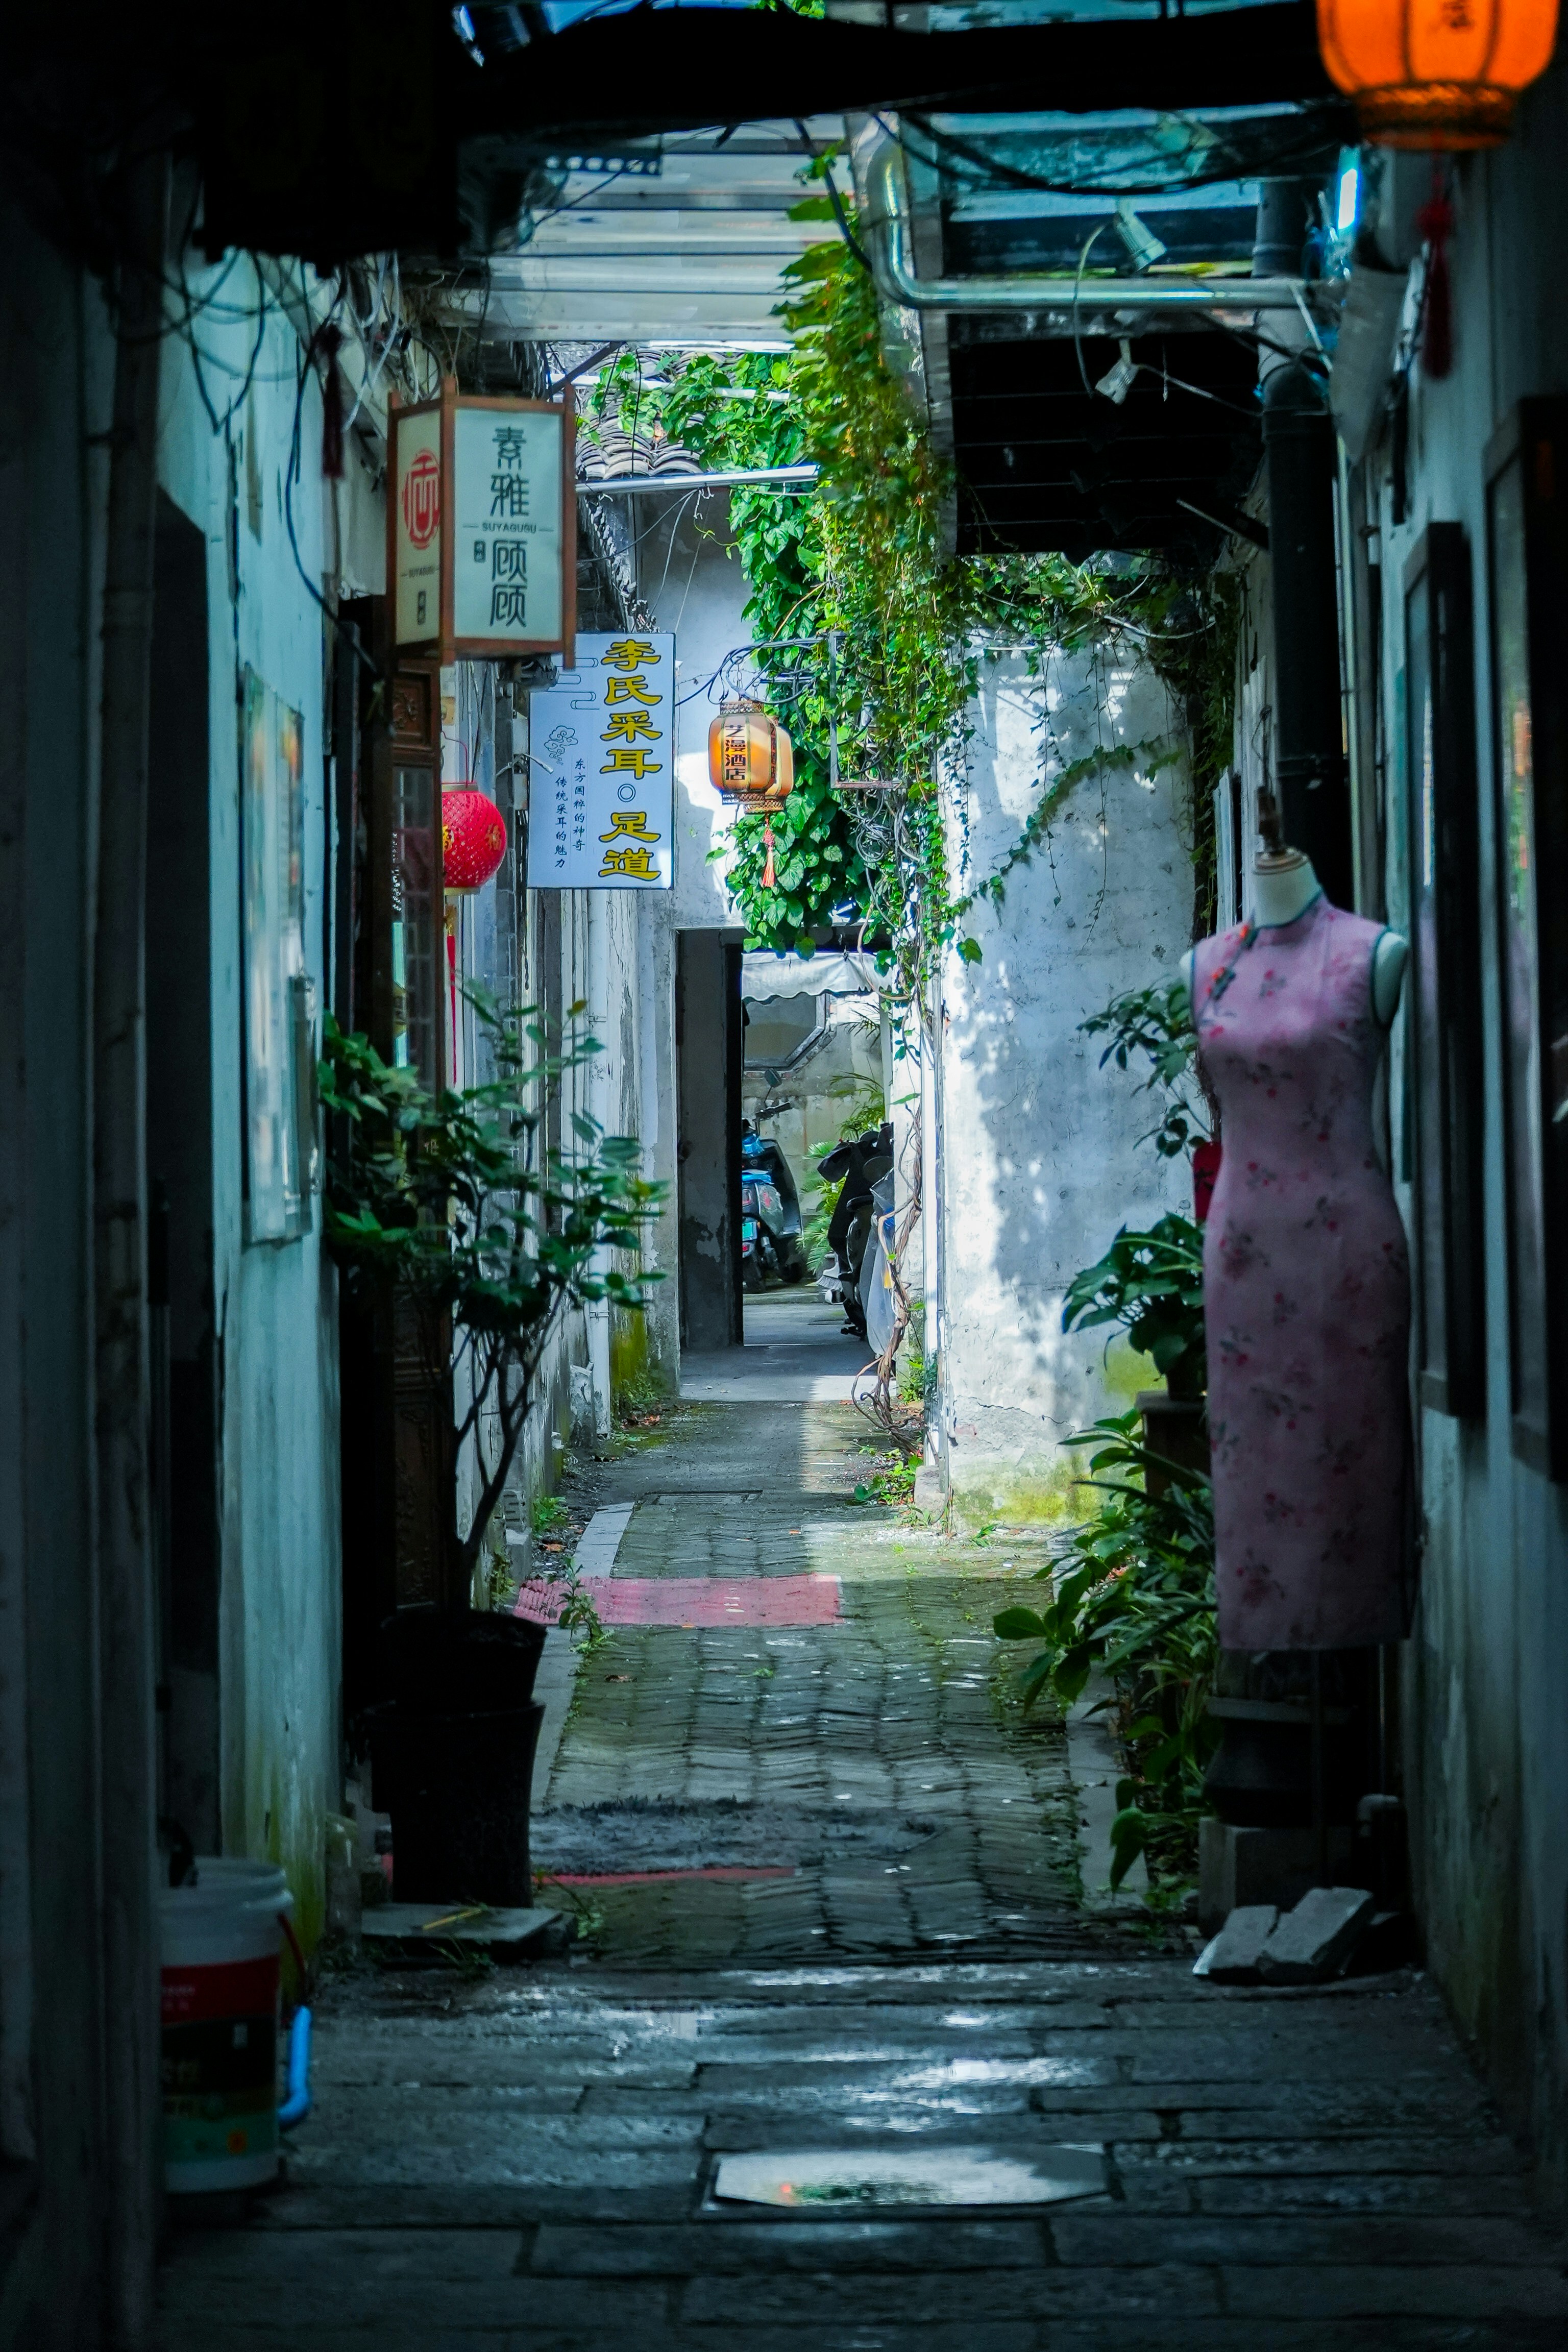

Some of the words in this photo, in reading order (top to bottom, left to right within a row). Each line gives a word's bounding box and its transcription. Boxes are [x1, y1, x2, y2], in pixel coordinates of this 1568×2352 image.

[482, 522, 536, 534] SUYAGUGU
[599, 639, 664, 780] 李氏采耳
[554, 776, 568, 869] 传统采耳的魅力
[598, 811, 662, 881] 足道
